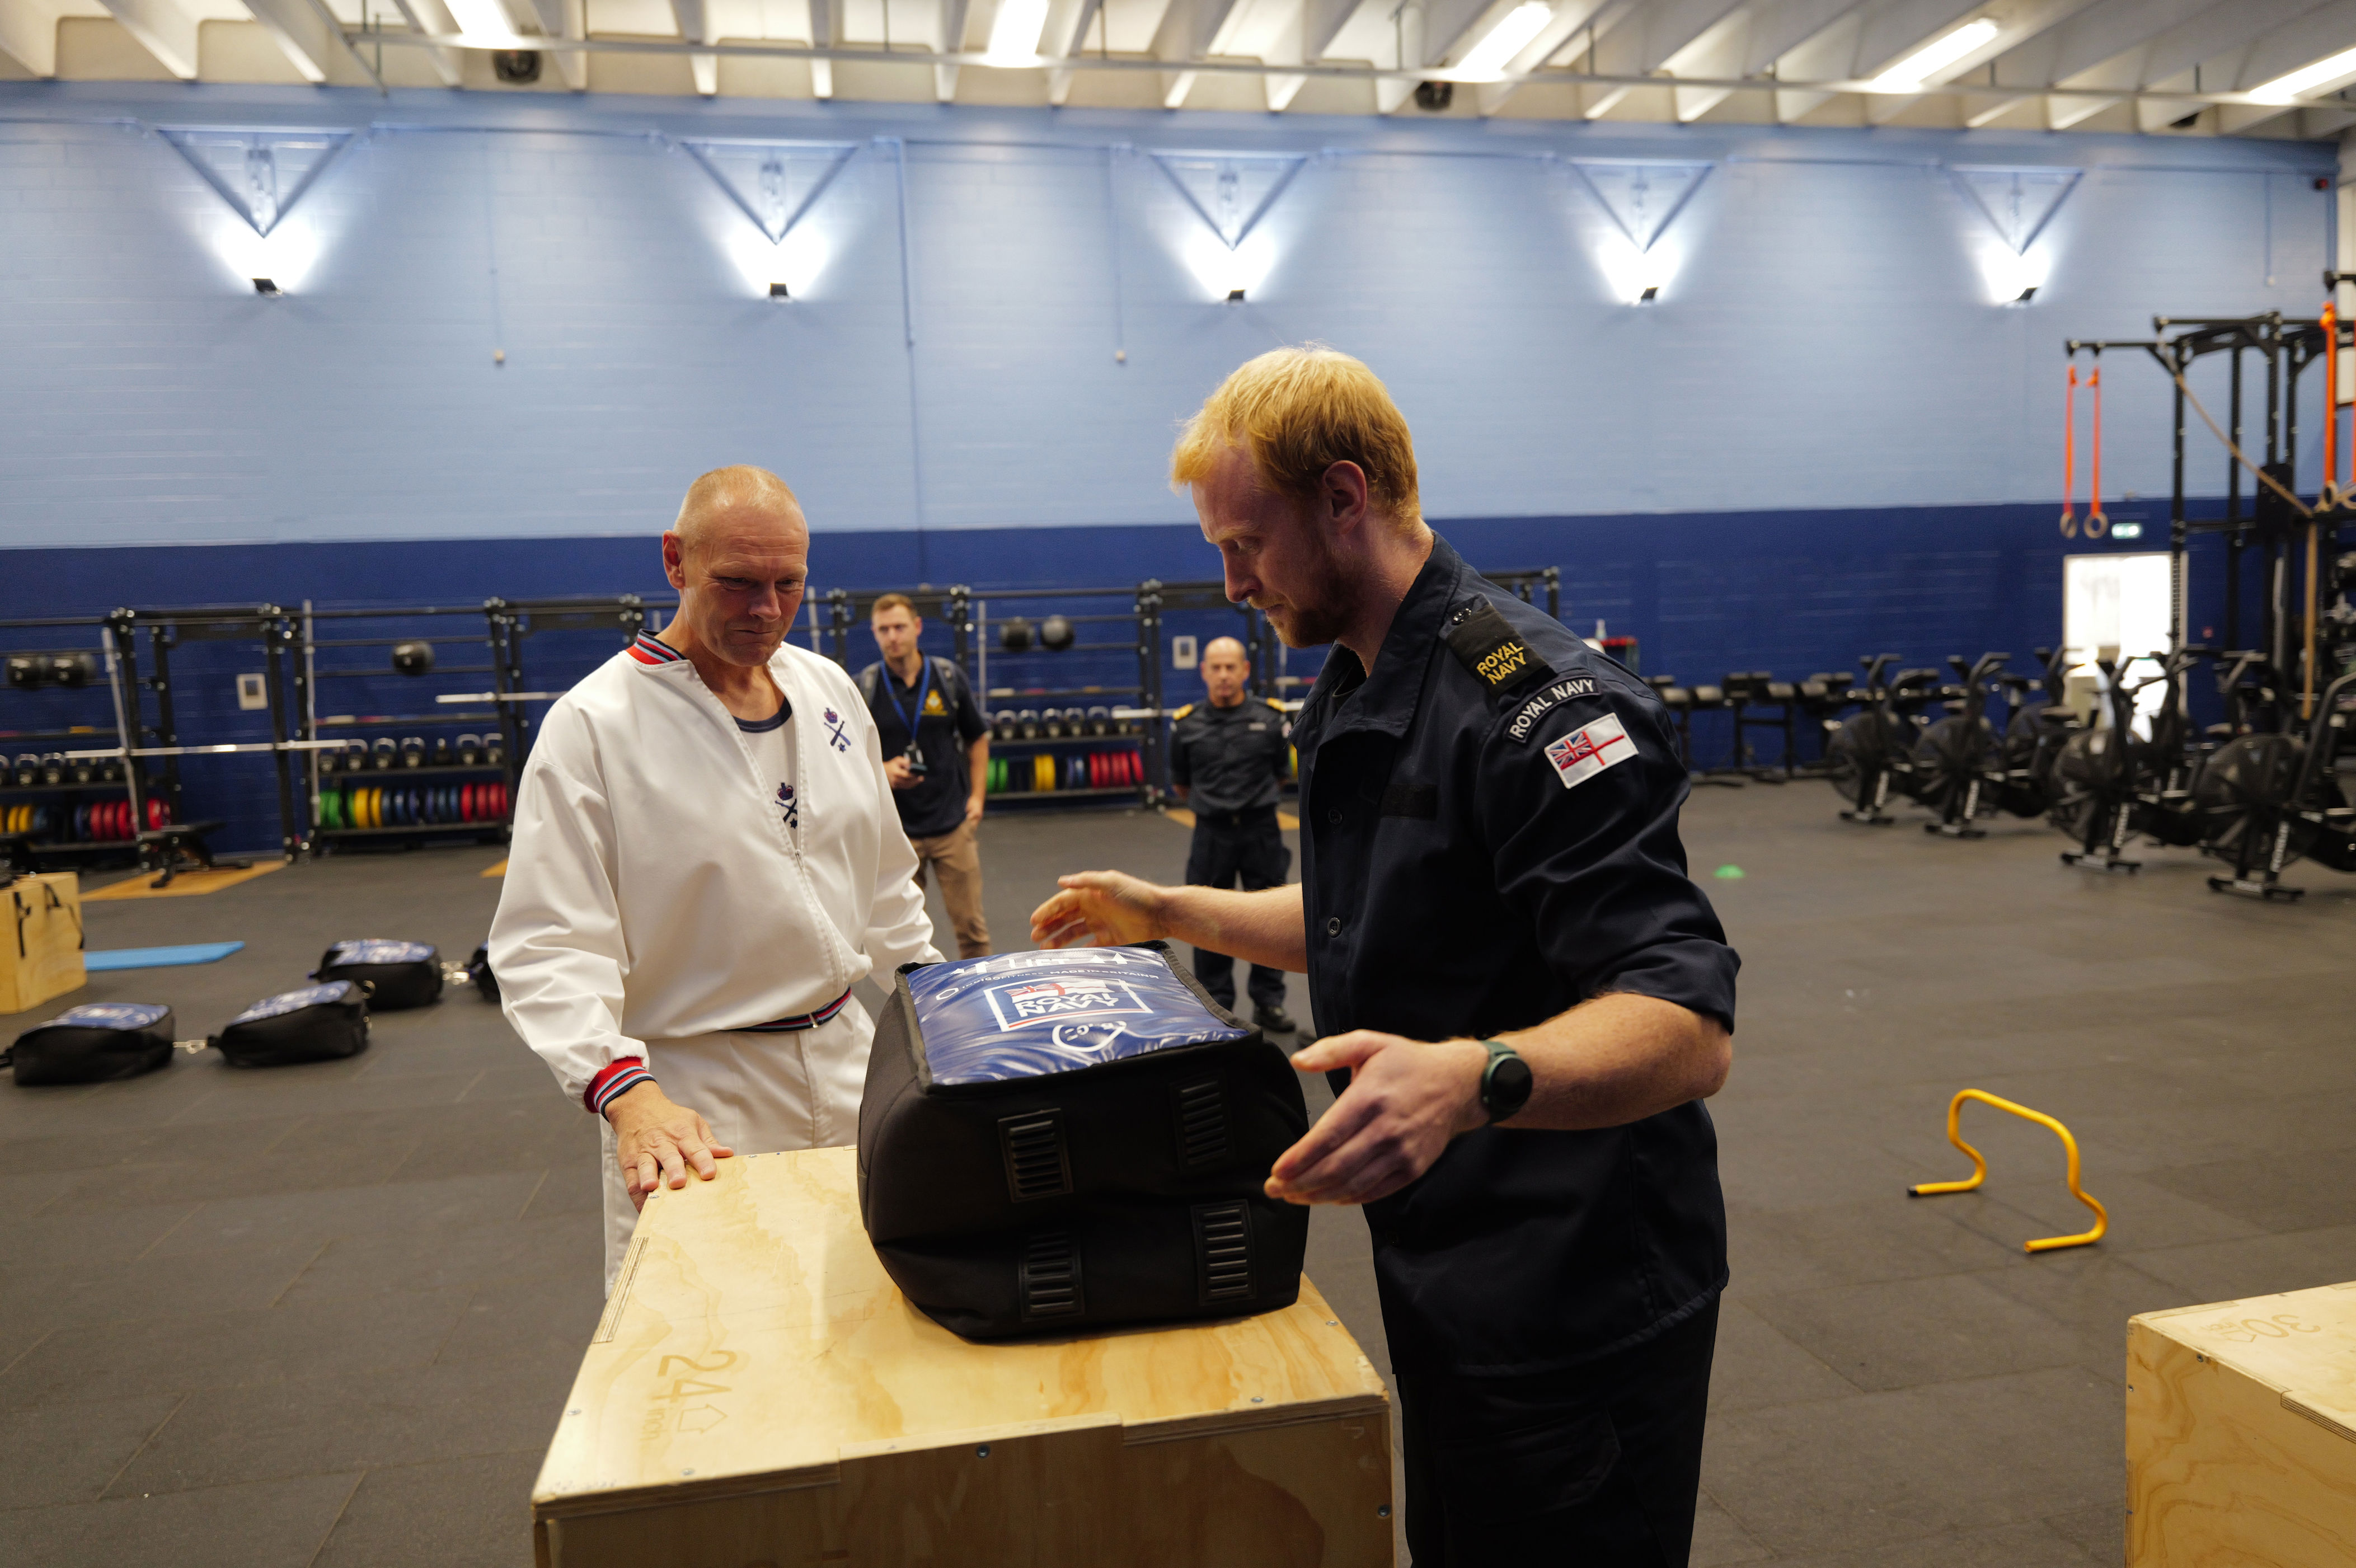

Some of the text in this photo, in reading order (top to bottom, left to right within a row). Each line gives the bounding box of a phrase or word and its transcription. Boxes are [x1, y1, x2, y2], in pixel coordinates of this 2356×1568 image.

[1476, 641, 1524, 676] ROYAL
[1486, 652, 1527, 686] NAVY
[1509, 678, 1594, 739] ROYAL NAVY
[1014, 993, 1119, 1010] ROYAL
[1017, 997, 1118, 1018] NAVY
[2240, 1314, 2322, 1338] 30
[651, 1350, 738, 1403] 24
